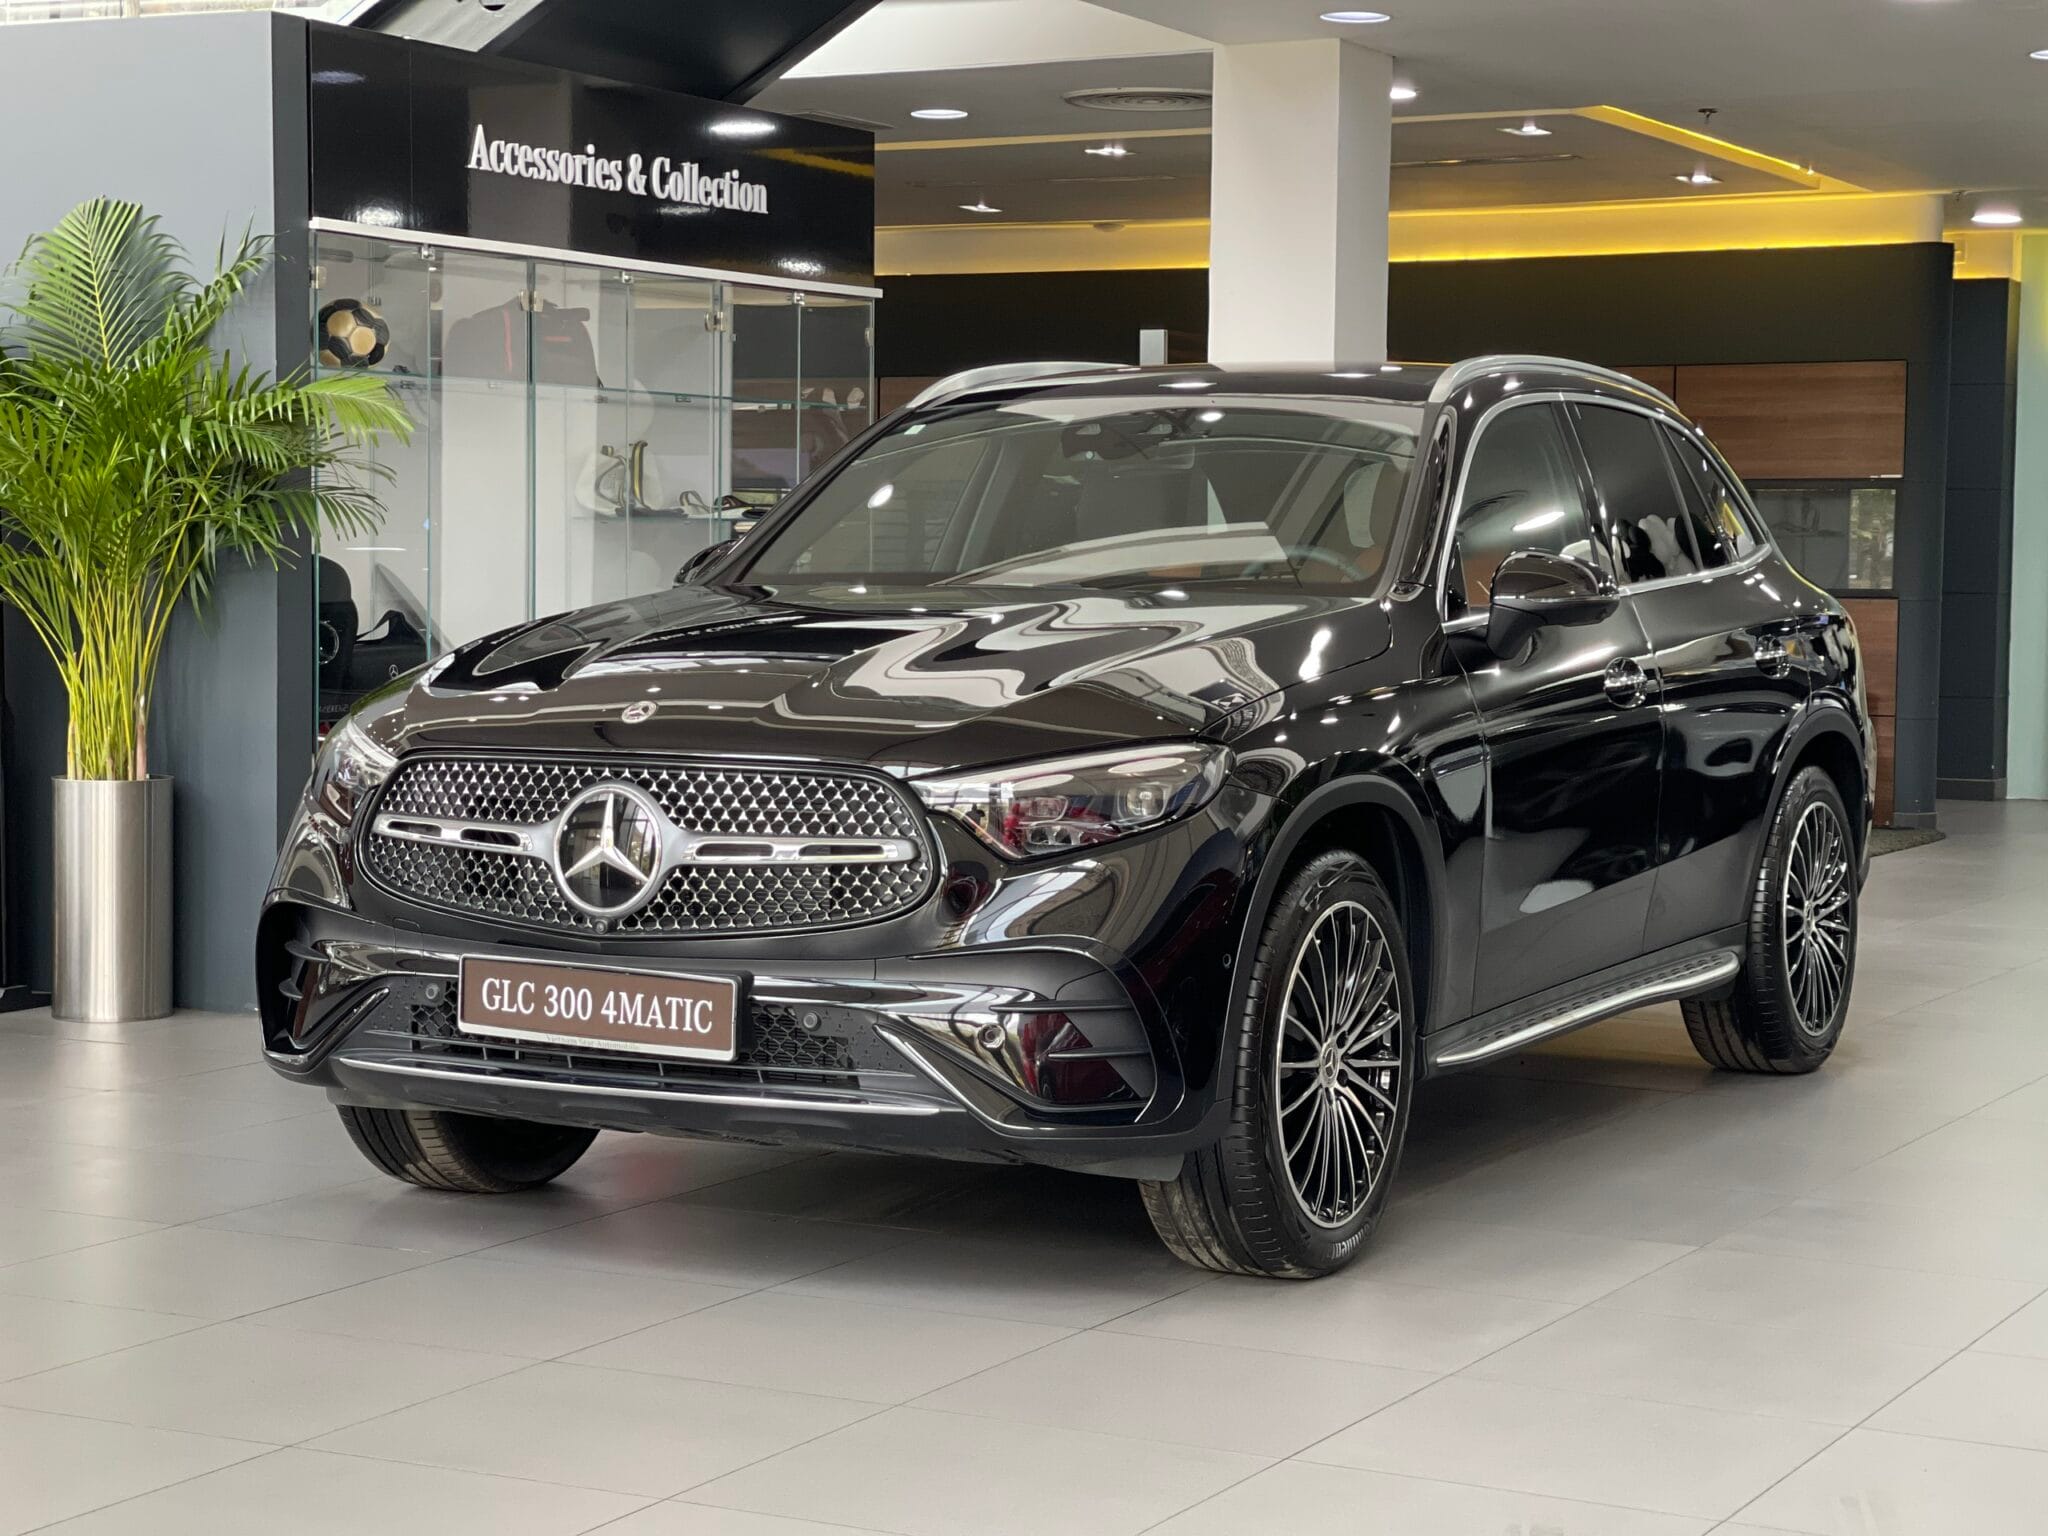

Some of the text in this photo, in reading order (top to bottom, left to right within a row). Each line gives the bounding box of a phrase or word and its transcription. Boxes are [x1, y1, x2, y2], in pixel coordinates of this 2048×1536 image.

[466, 124, 769, 214] Accessories & Collection
[481, 977, 713, 1034] GLC 300 4MATIC
